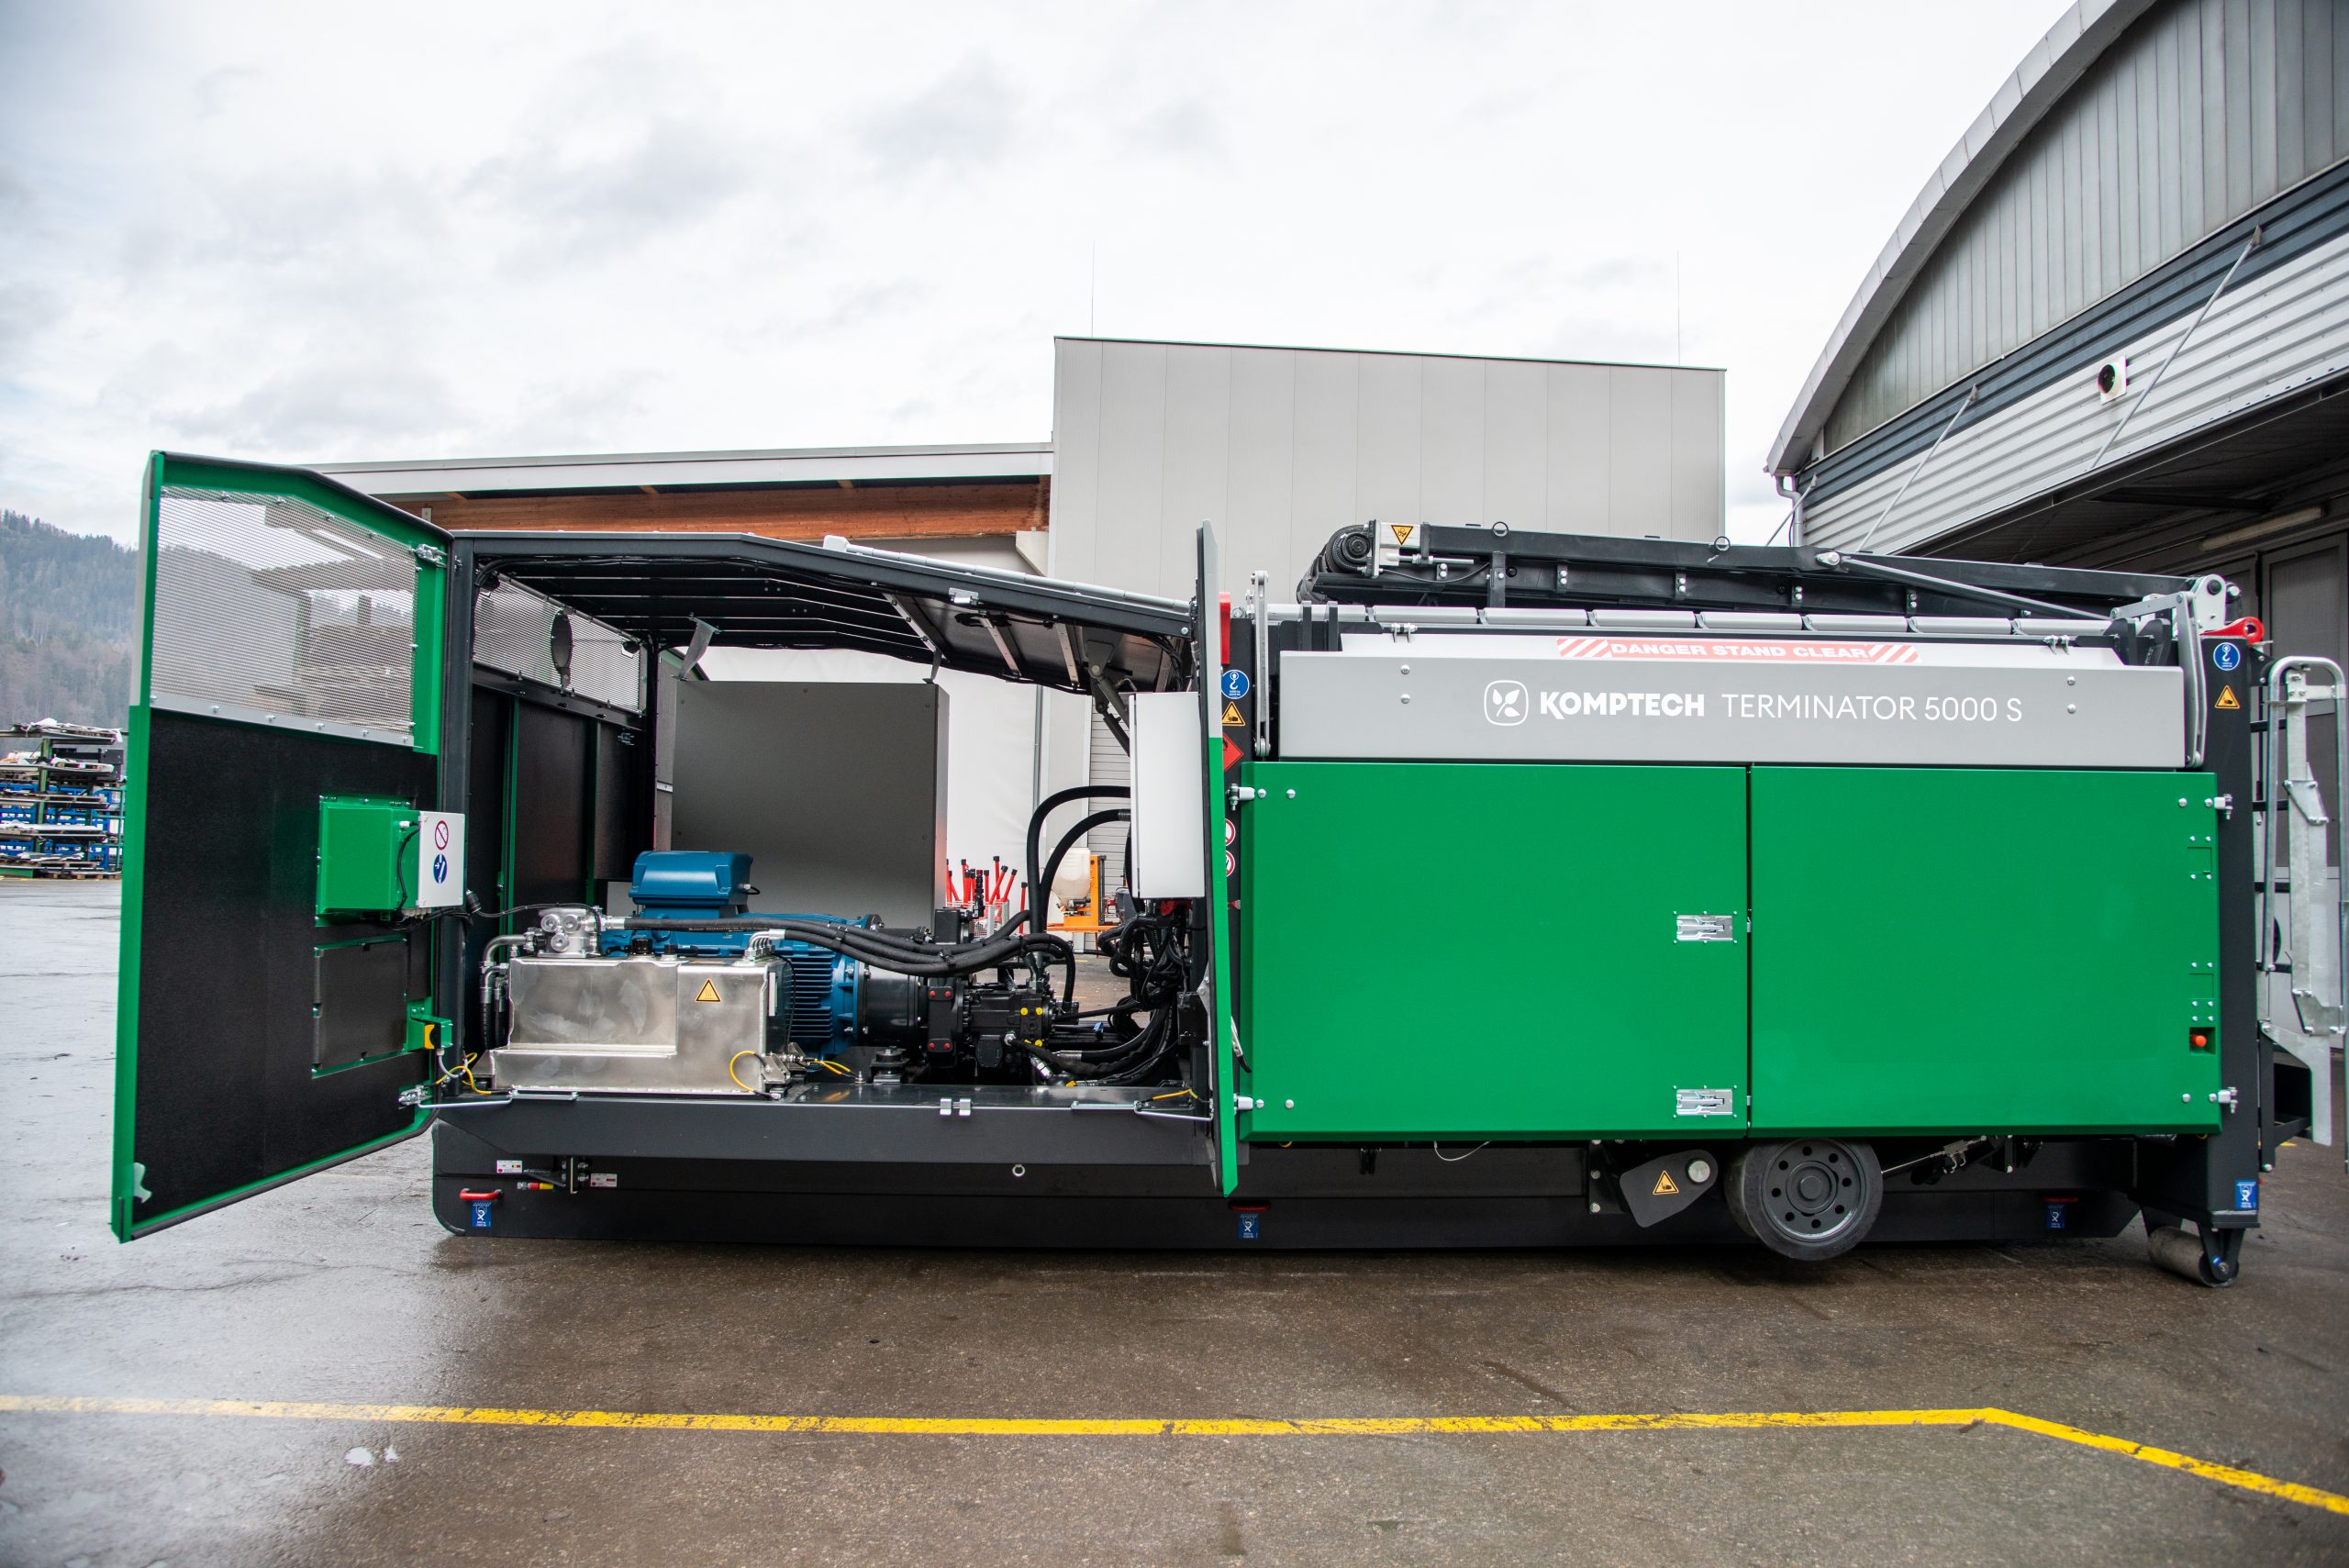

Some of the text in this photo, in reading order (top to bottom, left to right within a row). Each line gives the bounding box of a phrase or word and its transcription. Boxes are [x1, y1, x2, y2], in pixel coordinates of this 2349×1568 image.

[1609, 643, 1869, 659] DANGER STAND CLEAR
[1540, 691, 2022, 722] KOMPTECH TERMINATOR 5000 S
